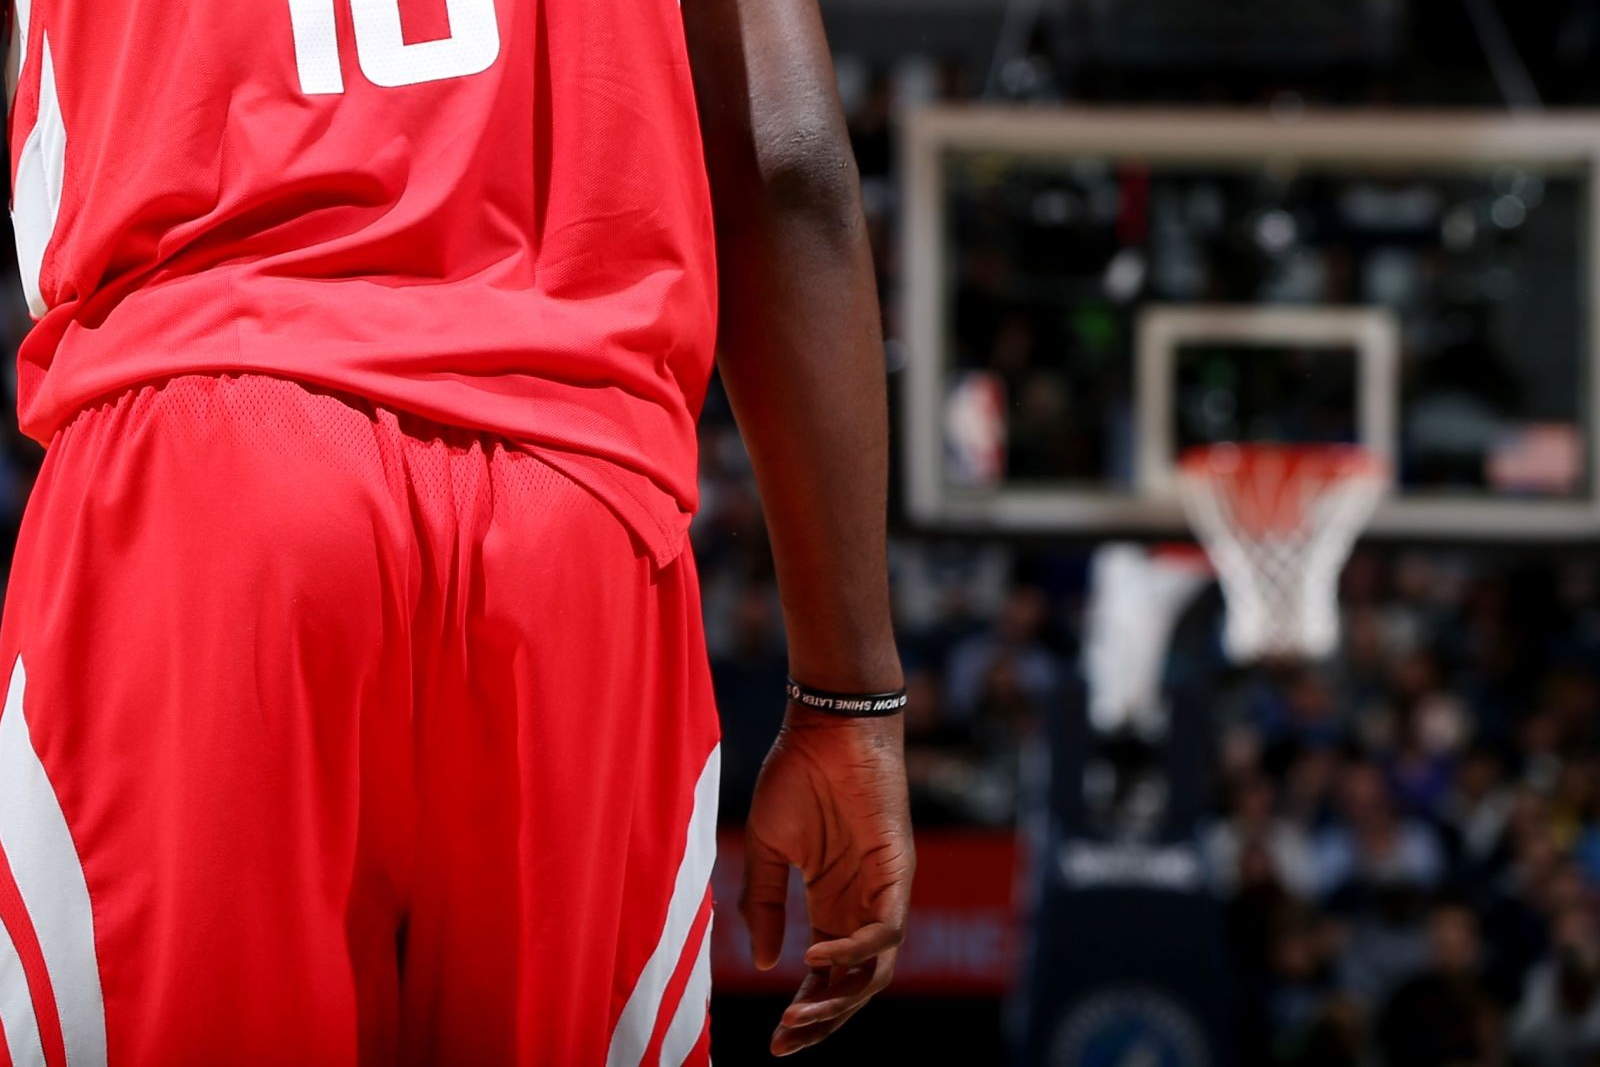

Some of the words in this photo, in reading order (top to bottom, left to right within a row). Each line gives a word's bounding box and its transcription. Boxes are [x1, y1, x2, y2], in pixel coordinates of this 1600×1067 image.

[802, 694, 833, 709] LATER
[835, 699, 872, 711] SHINE
[873, 698, 900, 711] NOW
